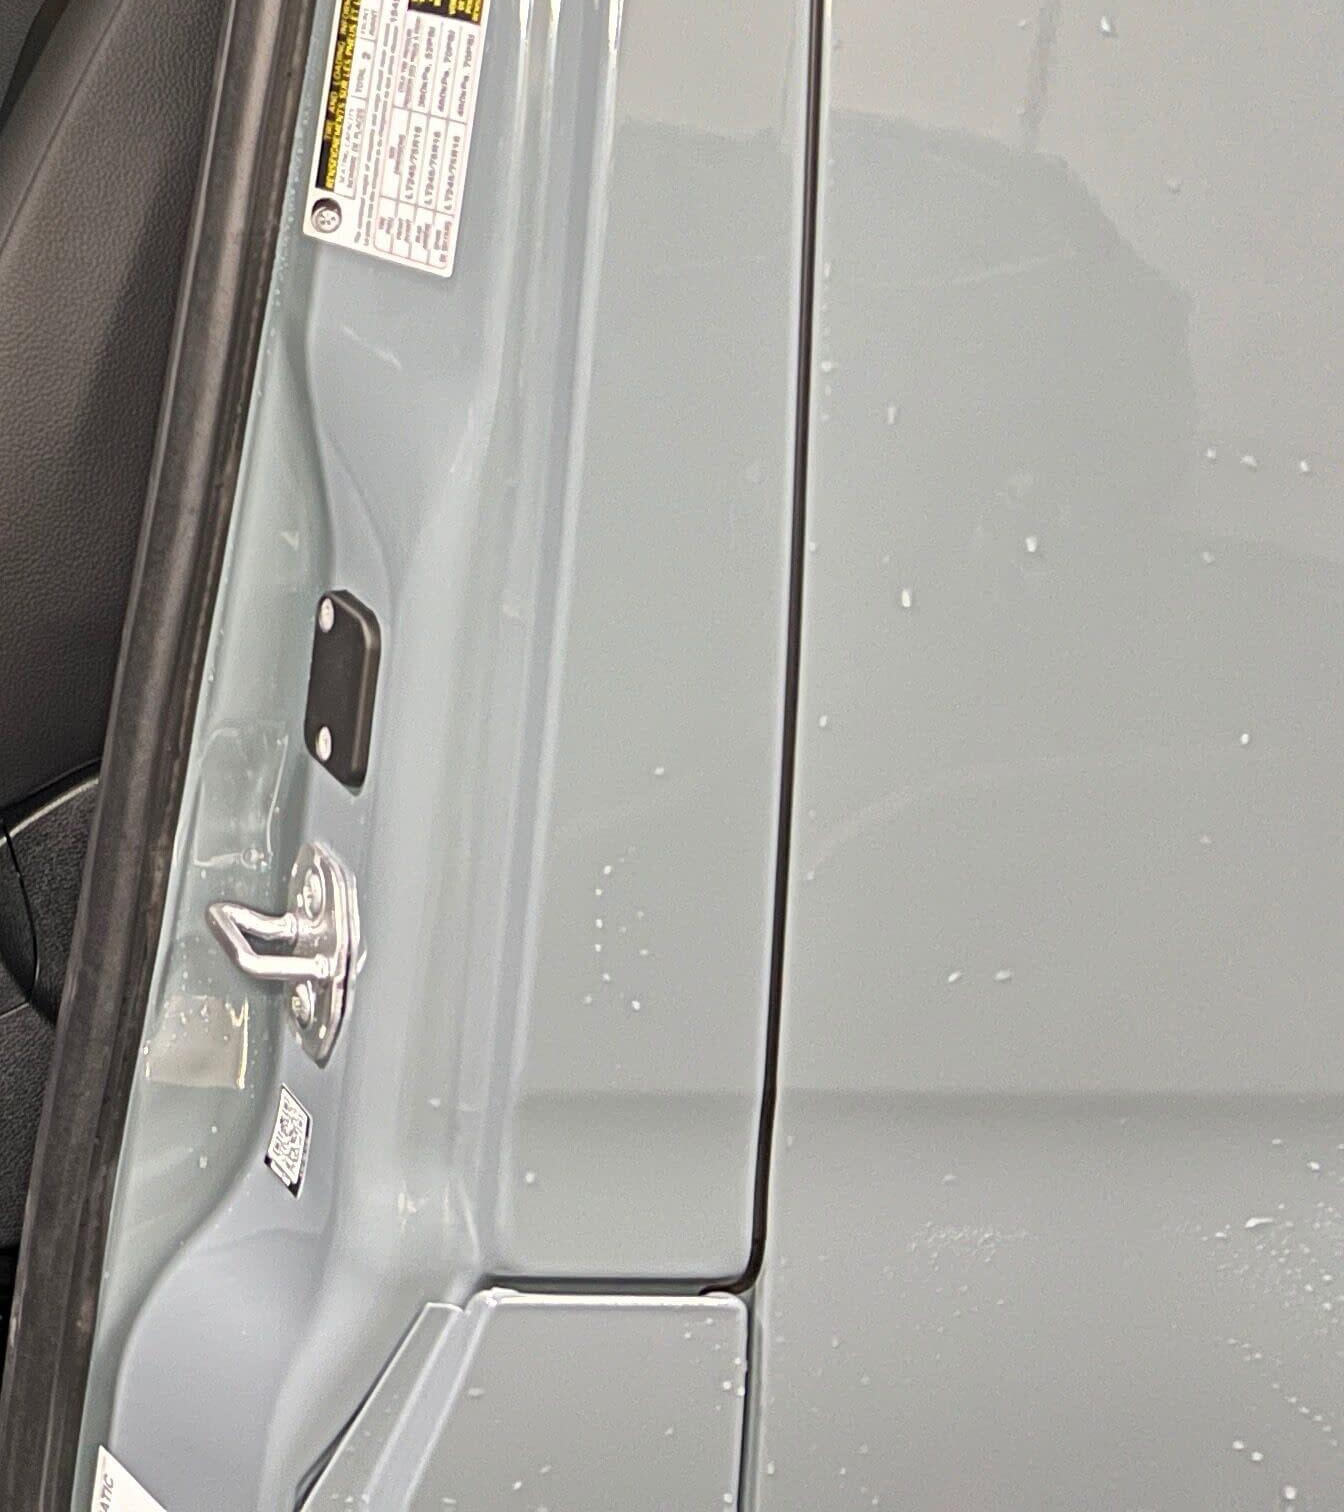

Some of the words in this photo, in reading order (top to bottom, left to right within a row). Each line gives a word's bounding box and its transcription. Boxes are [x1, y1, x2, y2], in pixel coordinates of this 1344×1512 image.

[350, 8, 358, 20] ET
[345, 23, 356, 56] PNEUS
[331, 37, 346, 85] LOADING
[342, 57, 351, 77] LES
[355, 67, 366, 93] TOTAL
[361, 51, 371, 61] 2
[328, 90, 337, 113] AND
[339, 79, 348, 98] SUR
[324, 119, 332, 140] TIRE
[325, 101, 345, 189] RENSEIGNEMENTS
[98, 1473, 114, 1512] ATIC
